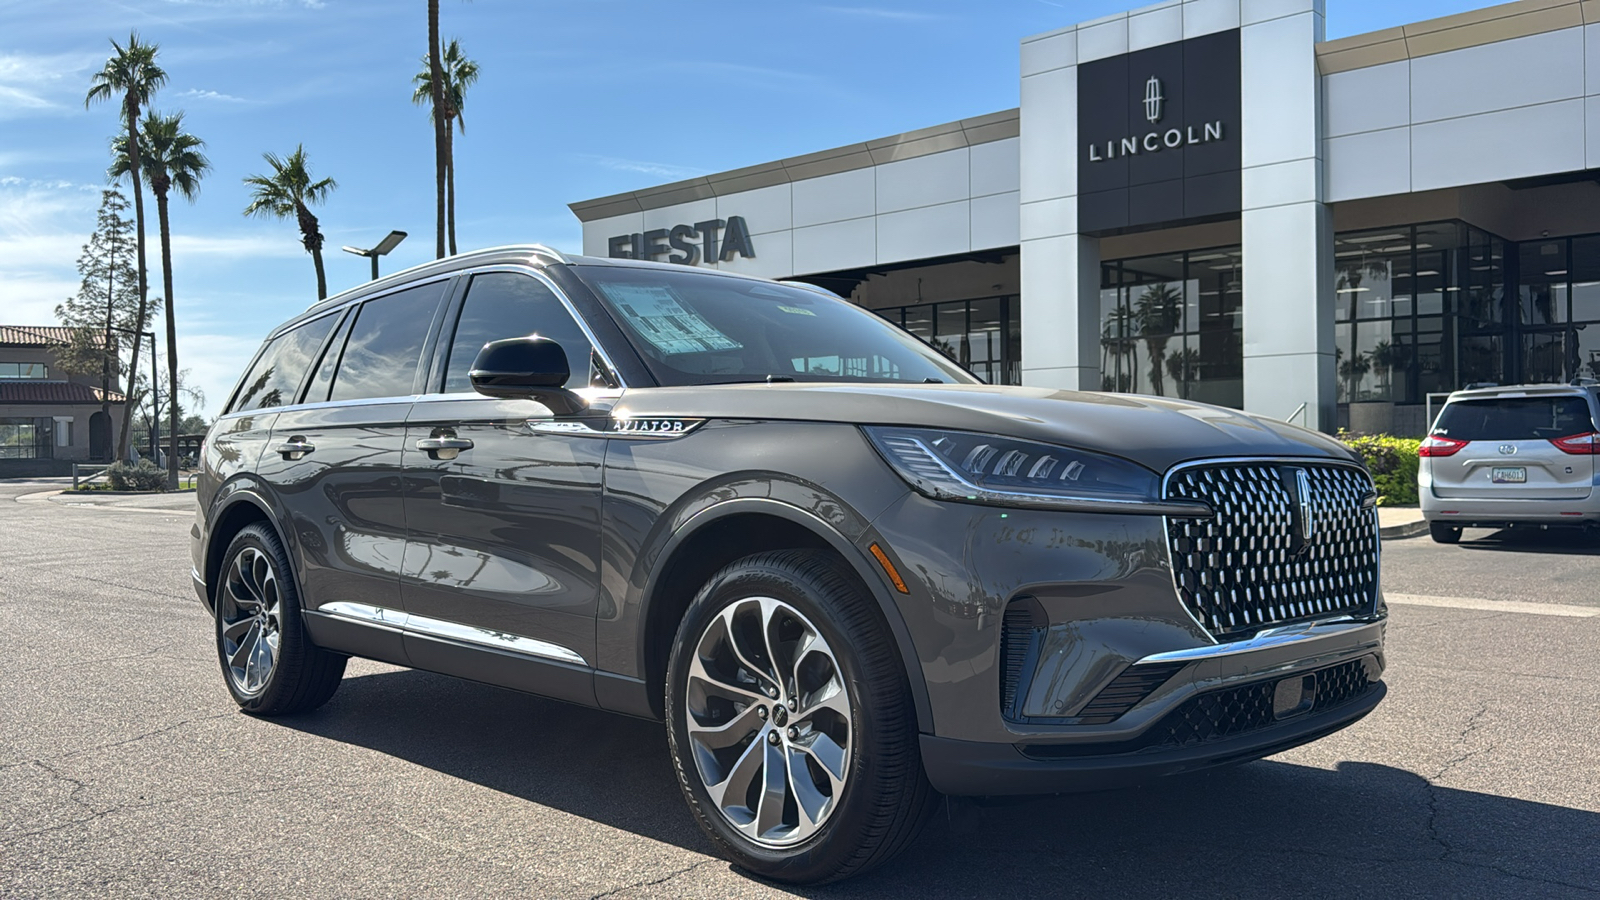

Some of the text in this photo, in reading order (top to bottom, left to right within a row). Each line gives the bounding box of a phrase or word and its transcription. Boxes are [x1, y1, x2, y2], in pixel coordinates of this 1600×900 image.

[1089, 120, 1223, 162] LINCOLN
[608, 215, 756, 266] FIESTA
[613, 420, 683, 432] AVIATOR
